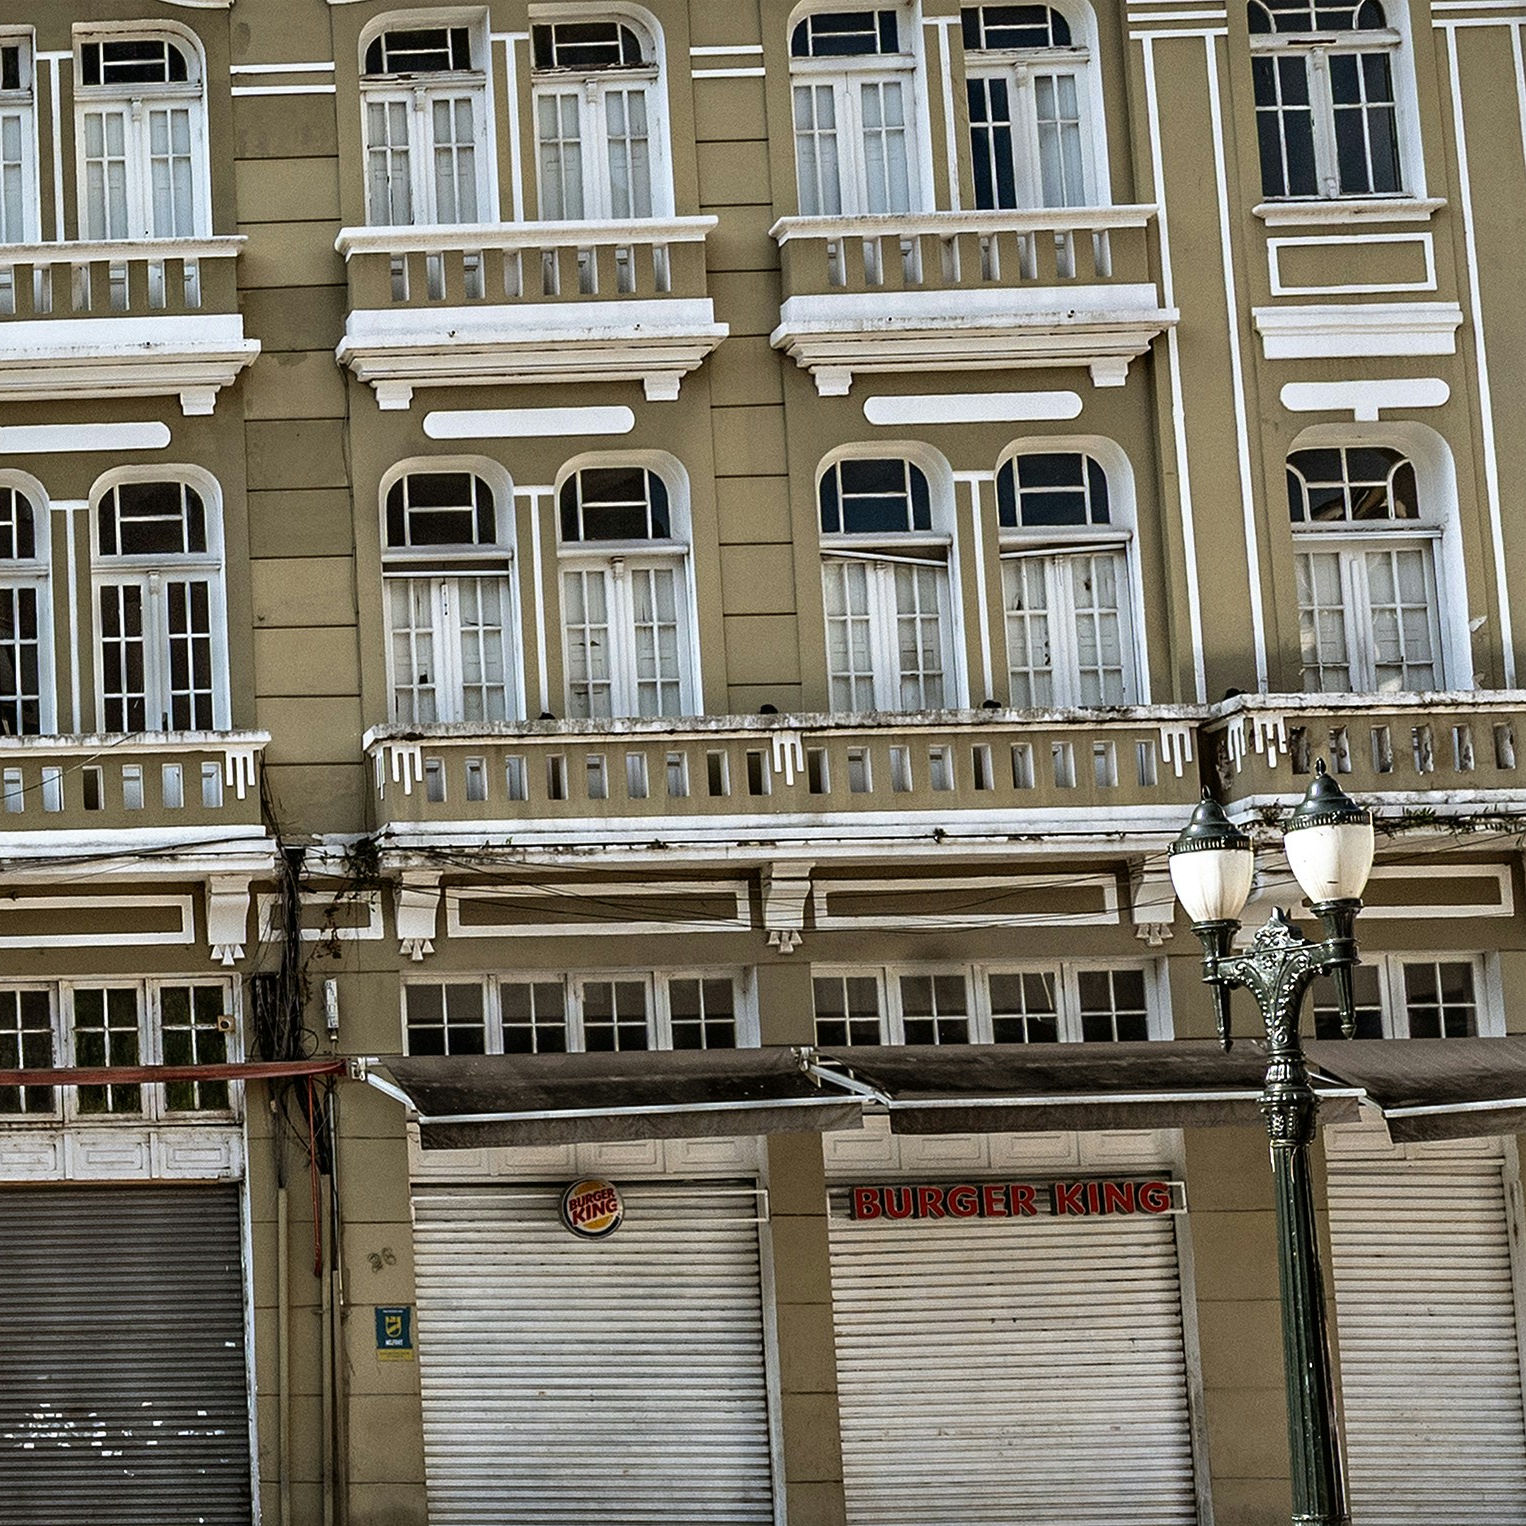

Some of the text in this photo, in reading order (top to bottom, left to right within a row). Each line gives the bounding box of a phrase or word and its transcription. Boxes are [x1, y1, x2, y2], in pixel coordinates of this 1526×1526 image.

[569, 1188, 615, 1211] BURGER
[572, 1198, 618, 1225] KING
[852, 1180, 1172, 1221] BURGER KING
